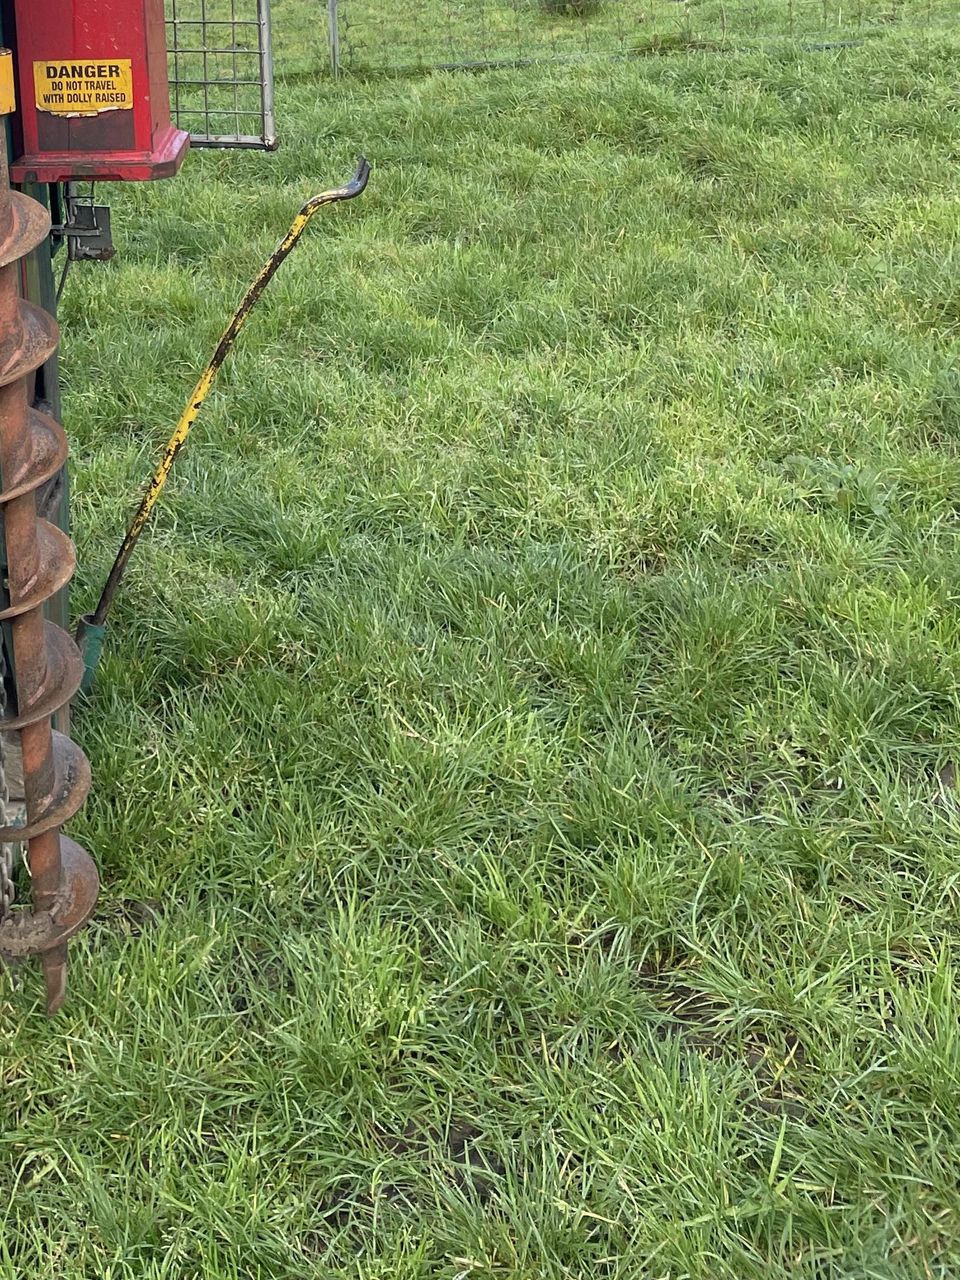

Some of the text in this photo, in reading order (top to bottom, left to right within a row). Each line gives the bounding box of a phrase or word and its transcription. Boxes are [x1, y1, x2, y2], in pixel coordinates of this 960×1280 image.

[46, 65, 120, 79] DANGER
[51, 80, 117, 91] DO NOT TRAVEL
[43, 92, 126, 103] WITH DOLLY RAISED
